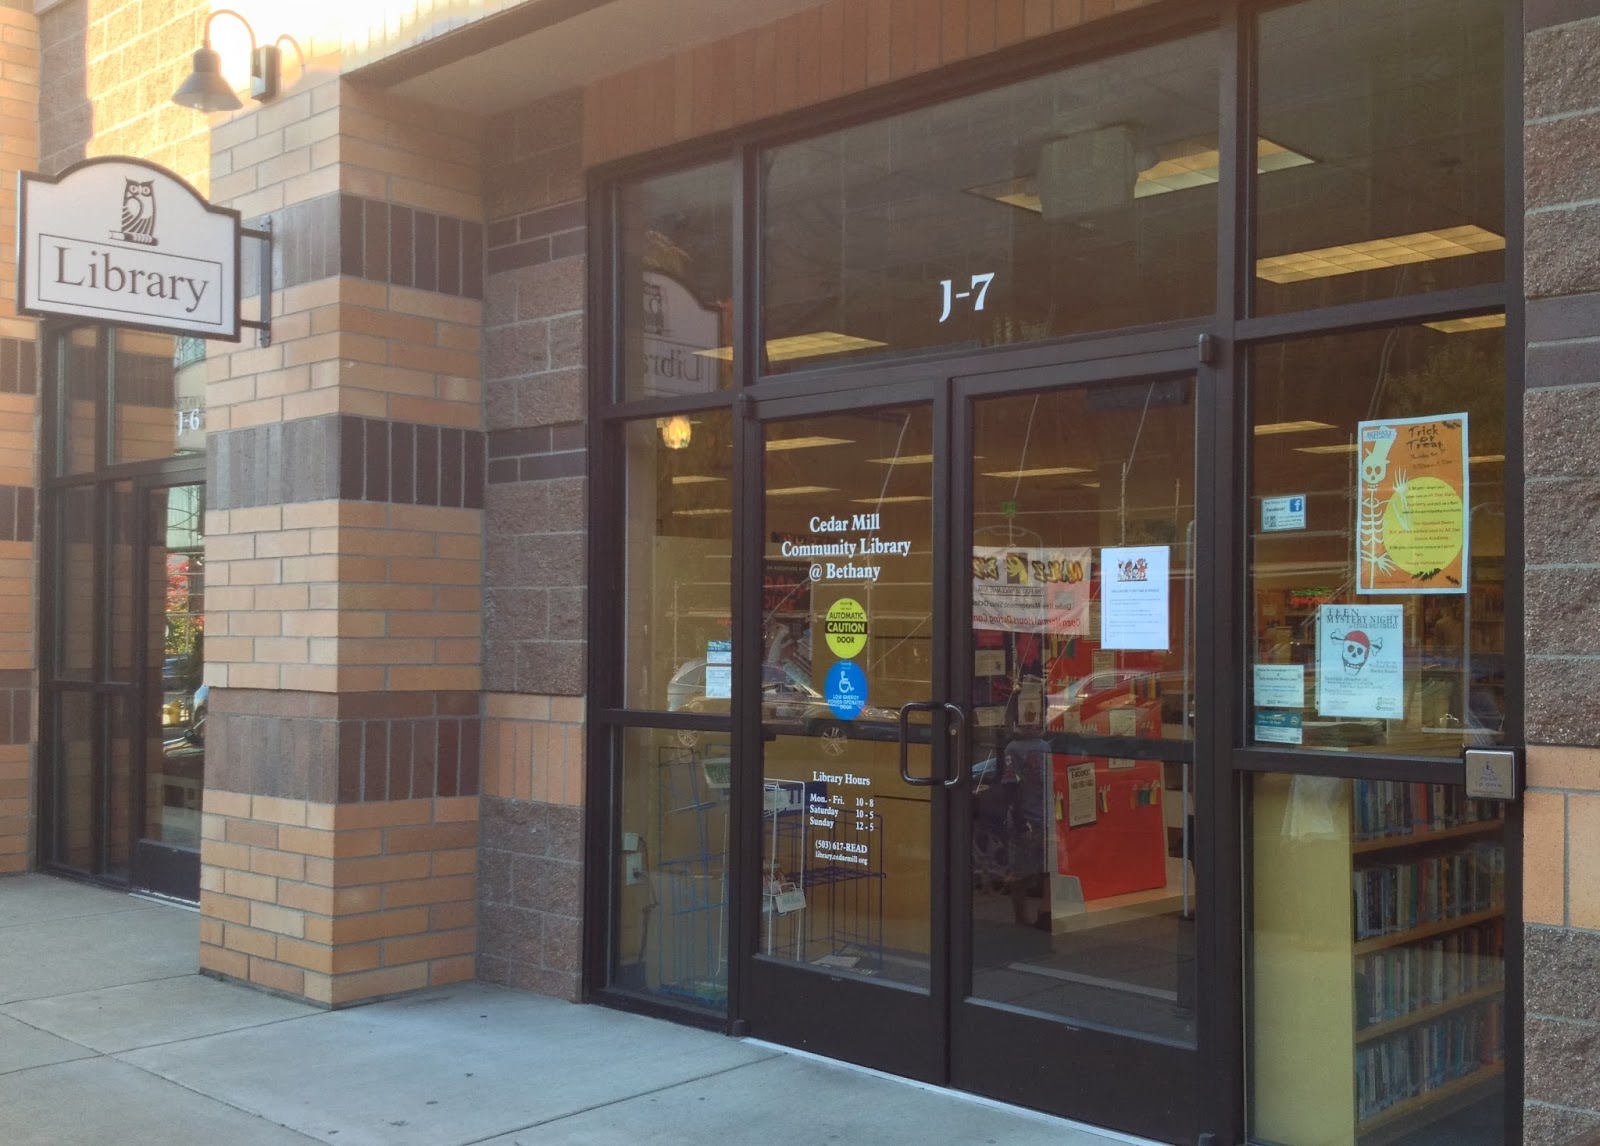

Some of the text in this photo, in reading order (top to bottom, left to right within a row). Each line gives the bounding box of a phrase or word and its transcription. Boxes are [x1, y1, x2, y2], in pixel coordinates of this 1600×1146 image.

[53, 245, 210, 314] Library
[938, 271, 995, 323] J-7
[177, 408, 200, 437] J-6
[1408, 424, 1439, 438] Trick
[1406, 440, 1444, 451] Treat
[809, 513, 880, 532] Cedar Mill
[781, 538, 911, 558] Community Library
[809, 563, 881, 582] @ Bethany
[1326, 615, 1399, 624] MYSTERY NIGHT
[1327, 608, 1360, 617] TEEN
[827, 622, 865, 633] CAUTION
[813, 771, 870, 785] Library Hours
[810, 793, 828, 803] Mon.
[832, 795, 845, 805] Fri.
[856, 797, 864, 807] 10
[869, 798, 874, 808] 8
[810, 804, 839, 818] Saturday
[856, 809, 864, 818] 10
[869, 810, 874, 820] 5
[810, 816, 834, 828] Sunday
[856, 821, 864, 831] 12
[869, 822, 874, 832] 5
[815, 839, 868, 854] (503) 617-READ
